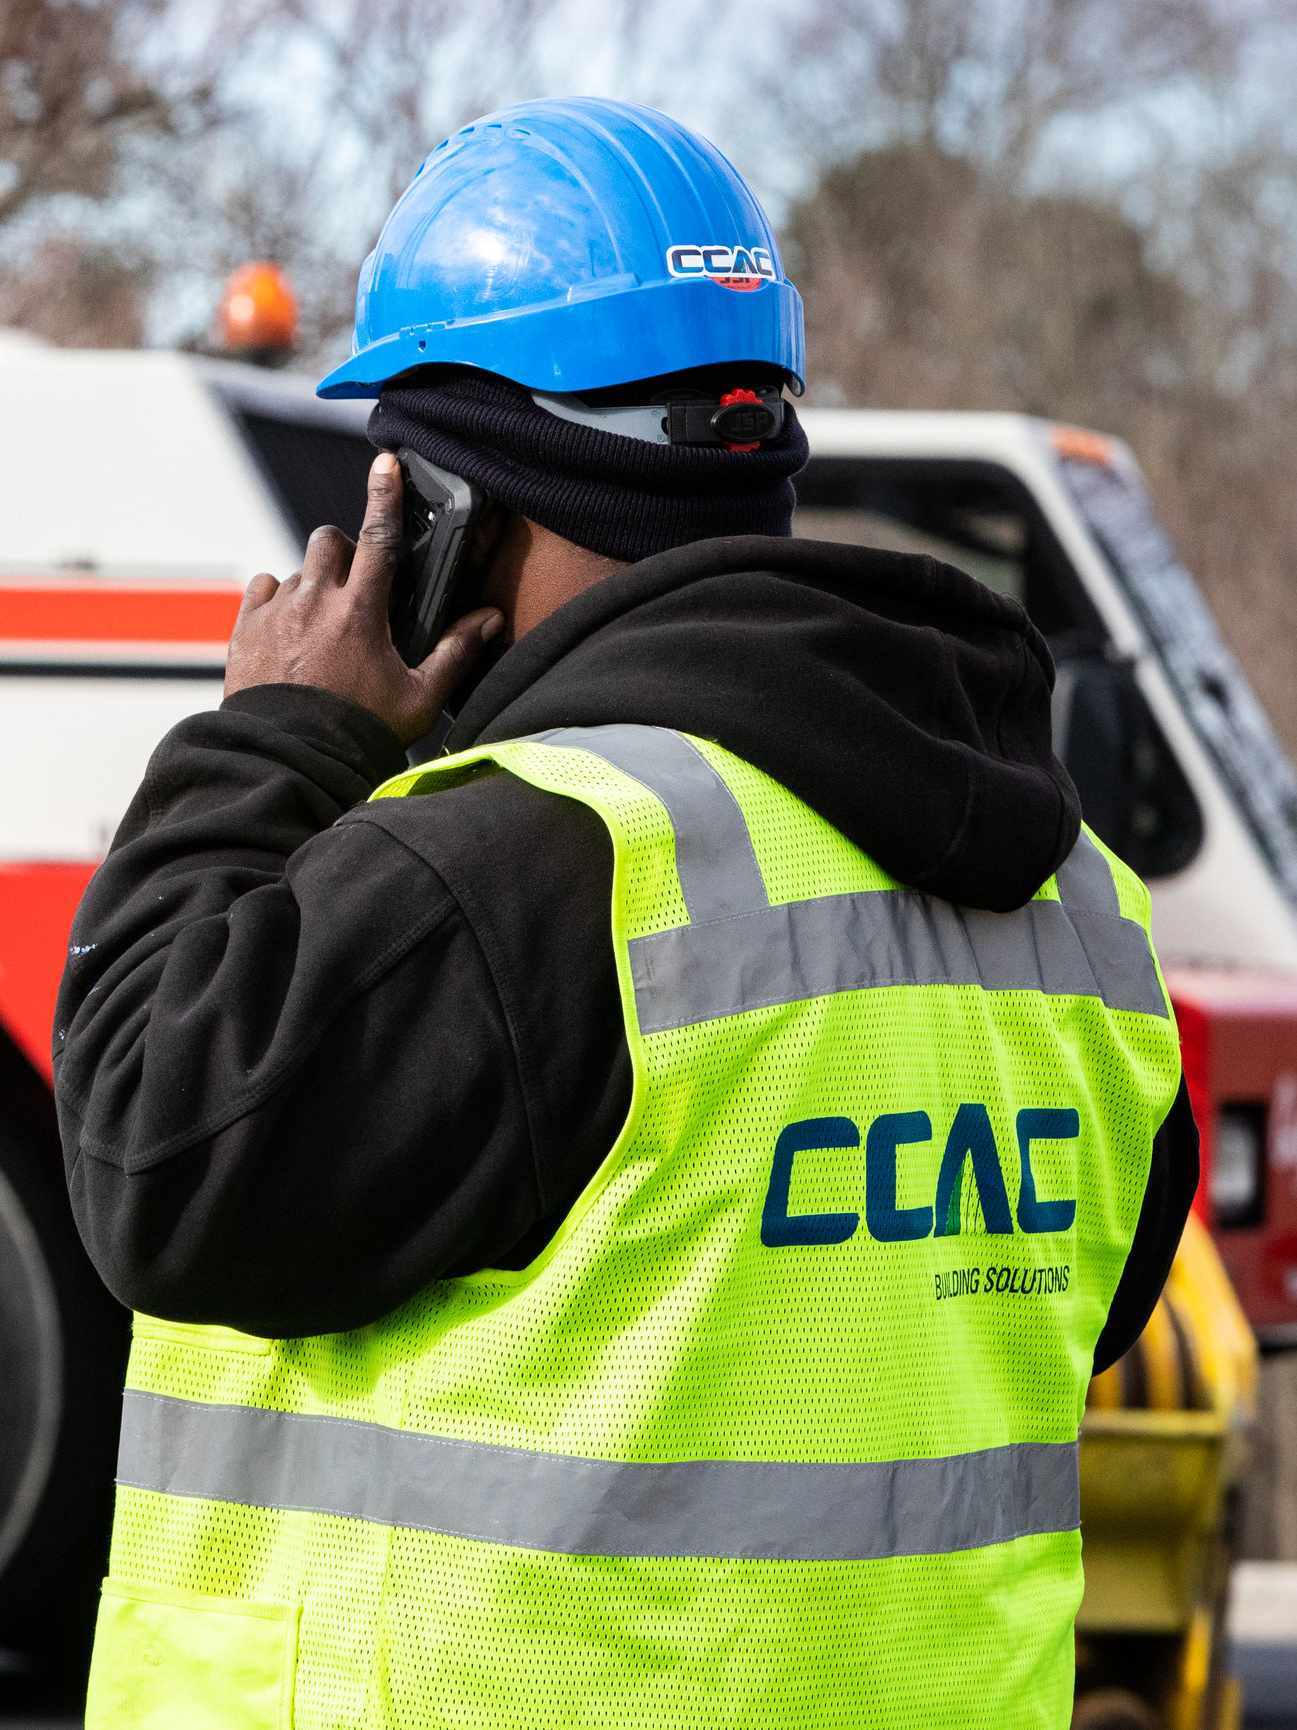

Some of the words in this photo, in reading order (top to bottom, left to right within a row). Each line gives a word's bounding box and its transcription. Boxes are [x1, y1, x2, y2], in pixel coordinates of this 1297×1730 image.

[670, 248, 773, 277] CCAC
[760, 1102, 1081, 1249] CCAC
[935, 1267, 980, 1301] BUILDING
[984, 1265, 1070, 1295] SOLUTIONS
